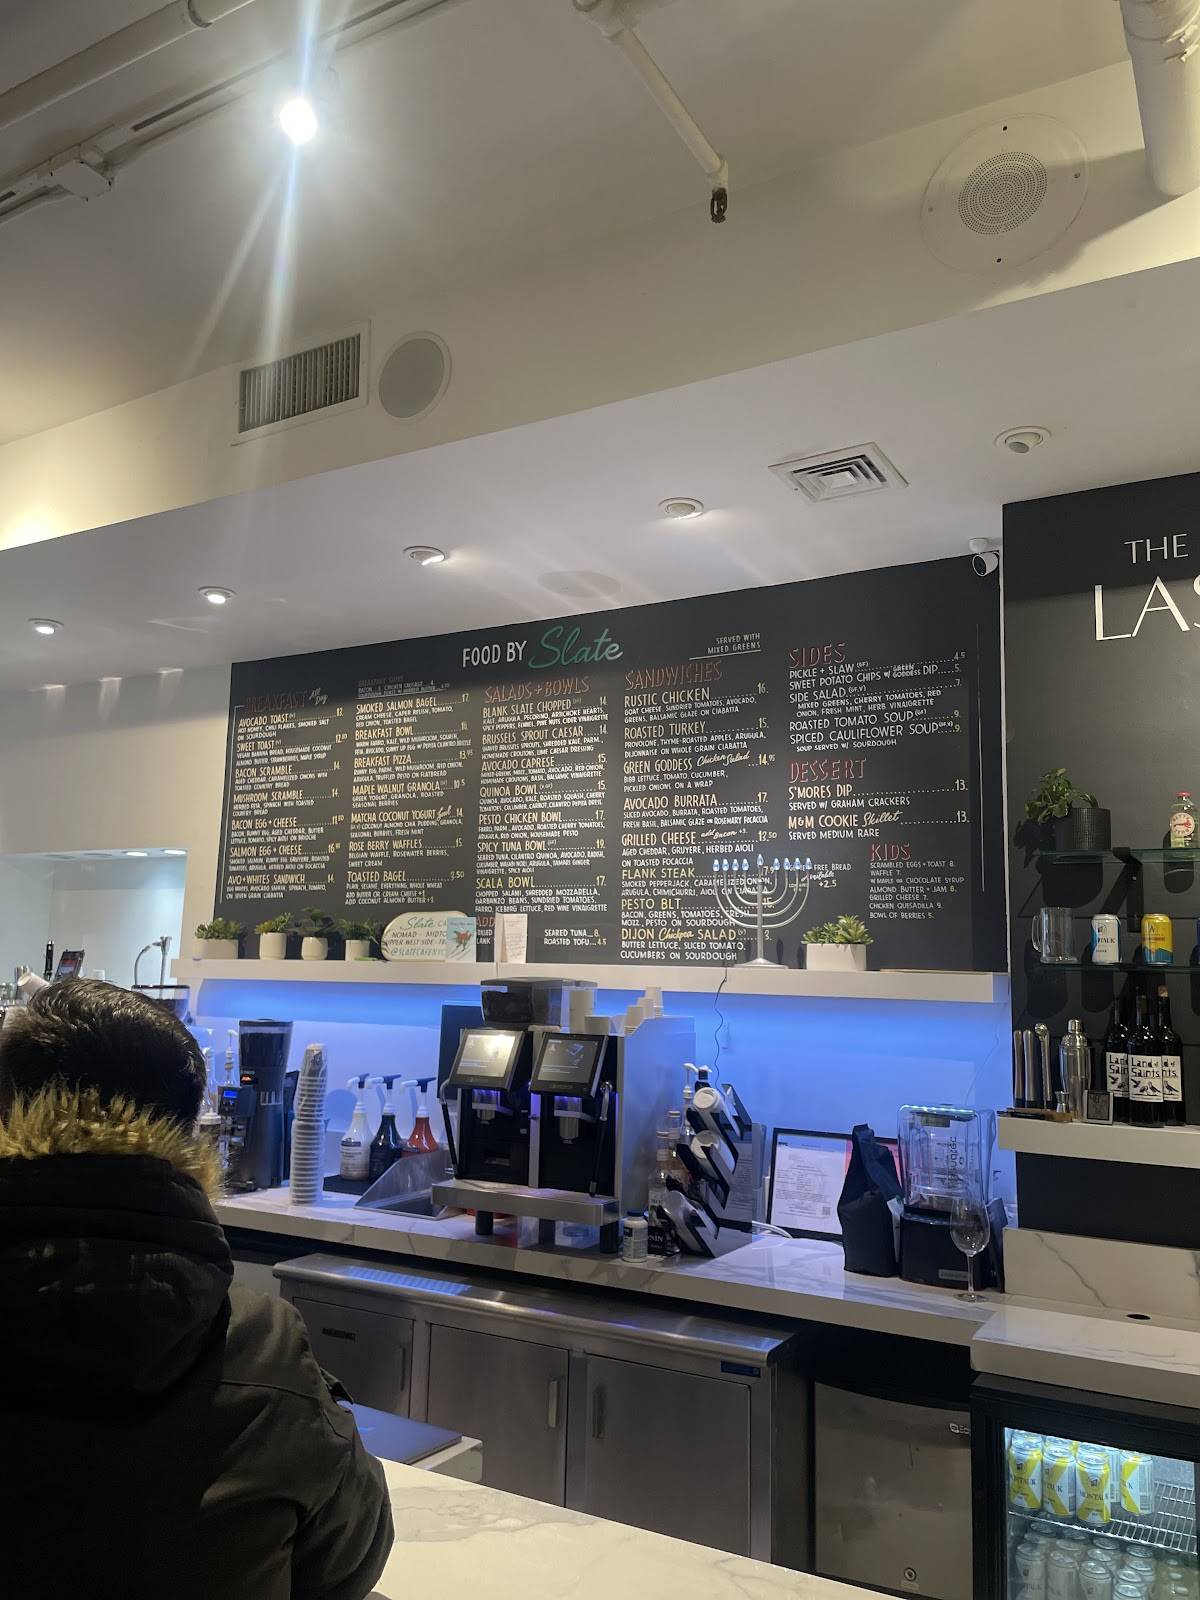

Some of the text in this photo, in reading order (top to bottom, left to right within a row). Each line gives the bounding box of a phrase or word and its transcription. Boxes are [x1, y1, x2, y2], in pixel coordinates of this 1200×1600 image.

[1124, 533, 1189, 564] THE
[1094, 574, 1200, 641] LA
[716, 632, 761, 645] SERVED WITH
[463, 625, 624, 669] FOOD BY Slate
[707, 641, 761, 655] MIXED GREENS
[789, 641, 847, 669] SIDES
[625, 659, 723, 691] SANDWICHES
[789, 663, 855, 680] PICKLE SLAW
[789, 664, 939, 691] SWEET POTATO CHIPS DIP
[485, 675, 591, 704] SALADS BOWLS
[789, 687, 846, 704] SIDE SALAD
[355, 696, 438, 715] SMOKED SALMON BAGEL
[624, 687, 711, 709] RUSTIC CHICKEN
[797, 689, 942, 710] MIXED CHERRY RED
[482, 699, 572, 719] BLANK SLATE CHOPPED
[821, 698, 935, 716] FRESH HERB VINAIGRETTE
[238, 713, 289, 728] AVOCADO TOAST
[789, 710, 914, 732] ROASTED TOMATO SOUP
[354, 725, 414, 741] BREAKFAST BOWL
[482, 725, 584, 745] BRUSSELS SPROUT CAESAR
[624, 721, 706, 740] ROASTED TURKEY
[789, 722, 939, 745] SPICED CAULIFLOWER SOUP
[236, 740, 275, 753] SWEET TOAST
[814, 738, 897, 752] SERVED SOURDOUGH
[353, 754, 412, 769] BREAKFAST PIZZA
[481, 756, 556, 772] AVOCADO CAPRESE
[623, 760, 650, 775] GREEN
[654, 758, 693, 772] GODDESS
[696, 753, 727, 767] Chicken
[722, 750, 751, 767] Salad
[235, 765, 293, 779] BACON SCRAMBLE
[789, 757, 867, 784] DESSERT
[352, 780, 440, 796] MAPLE WALNUT GRANOLA
[479, 784, 539, 799] QUINOA BOWL
[788, 783, 853, 801] S'MORES DIP
[233, 790, 303, 804] MUSHROOM SCRAMBLE
[623, 793, 718, 811] AVOCADO BURRATA
[788, 795, 911, 811] SERVED GRAHAM CRACKERS
[231, 816, 297, 831] BACON EGG CHEESE
[350, 809, 436, 824] MATCHA COCONUT YOGURT
[478, 810, 563, 825] PESTO CHICKEN BOWL
[818, 814, 858, 828] COOKIE
[861, 810, 904, 828] Skillet
[621, 831, 697, 847] GRILLED CHEESE
[788, 827, 880, 841] SERVED MEDIUM RARE
[229, 844, 303, 858] SALMON EGG CHEESE
[348, 838, 423, 852] ROSE BERRY WAFFLES
[477, 840, 547, 853] SPICY TUNA BOWL
[870, 842, 912, 861] KIDS
[831, 863, 852, 871] BREAD
[869, 861, 922, 869] SCRAMBLED EGGS
[273, 873, 306, 885] SANDWICH
[346, 870, 407, 883] TOASTED BAGEL
[621, 867, 696, 879] FLANK STEAK
[905, 876, 965, 884] CHOCOLATE SYRUP
[476, 877, 536, 889] SCALA BOWL
[900, 885, 925, 893] BUTTER
[621, 898, 682, 910] PESTO BLT
[869, 893, 920, 901] GRILLED CHEESE
[869, 902, 934, 910] CHICKEN QUESADILLA
[869, 911, 926, 920] BOWL OF BERRIES
[544, 928, 587, 938] SEARED TUNA
[621, 927, 737, 942] DIJON Chickpea SALAD
[543, 937, 590, 946] ROASTED TOFU
[621, 940, 707, 950] BUTTER SLICED
[620, 950, 737, 961] CUCUMBERS ON SOURDOUGH
[1131, 1057, 1153, 1068] Land
[1131, 1067, 1160, 1078] Saints
